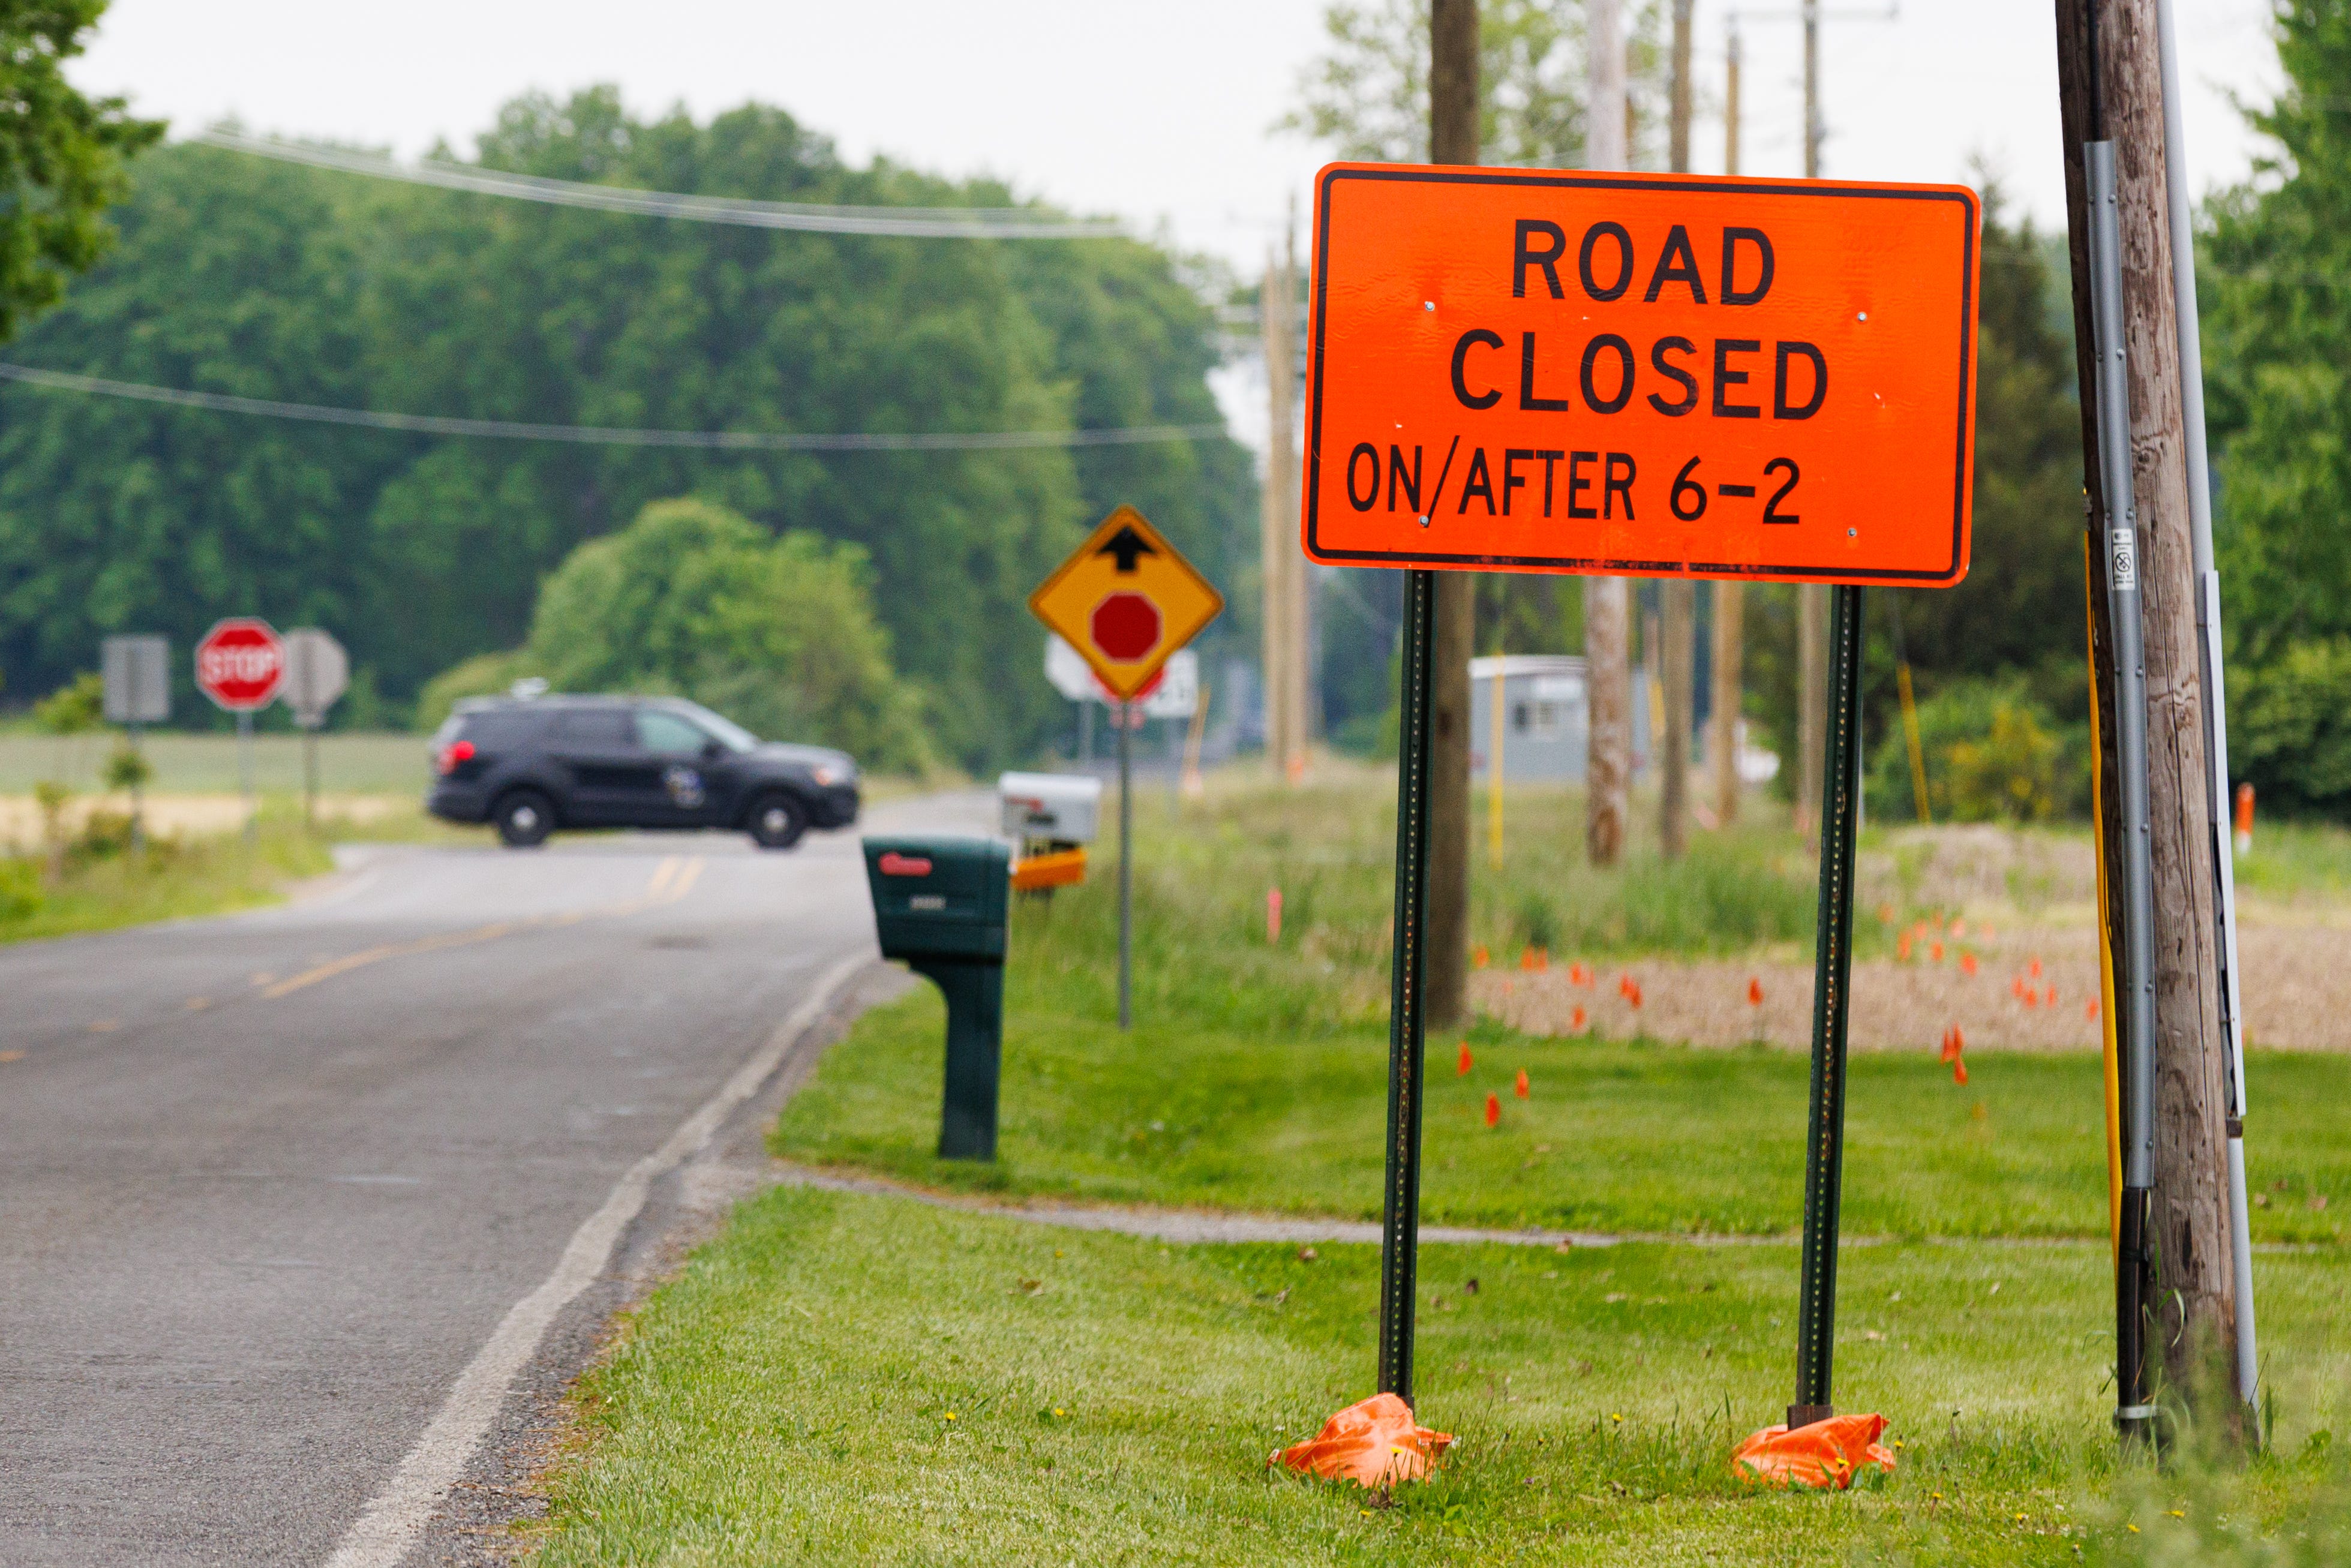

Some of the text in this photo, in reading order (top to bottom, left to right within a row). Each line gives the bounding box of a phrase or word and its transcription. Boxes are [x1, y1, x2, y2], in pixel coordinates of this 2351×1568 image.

[1512, 219, 1774, 306] ROAD
[1451, 329, 1828, 420] CLOSED
[1347, 435, 1800, 528] ON/AFTER 6-2
[200, 647, 277, 683] STOP
